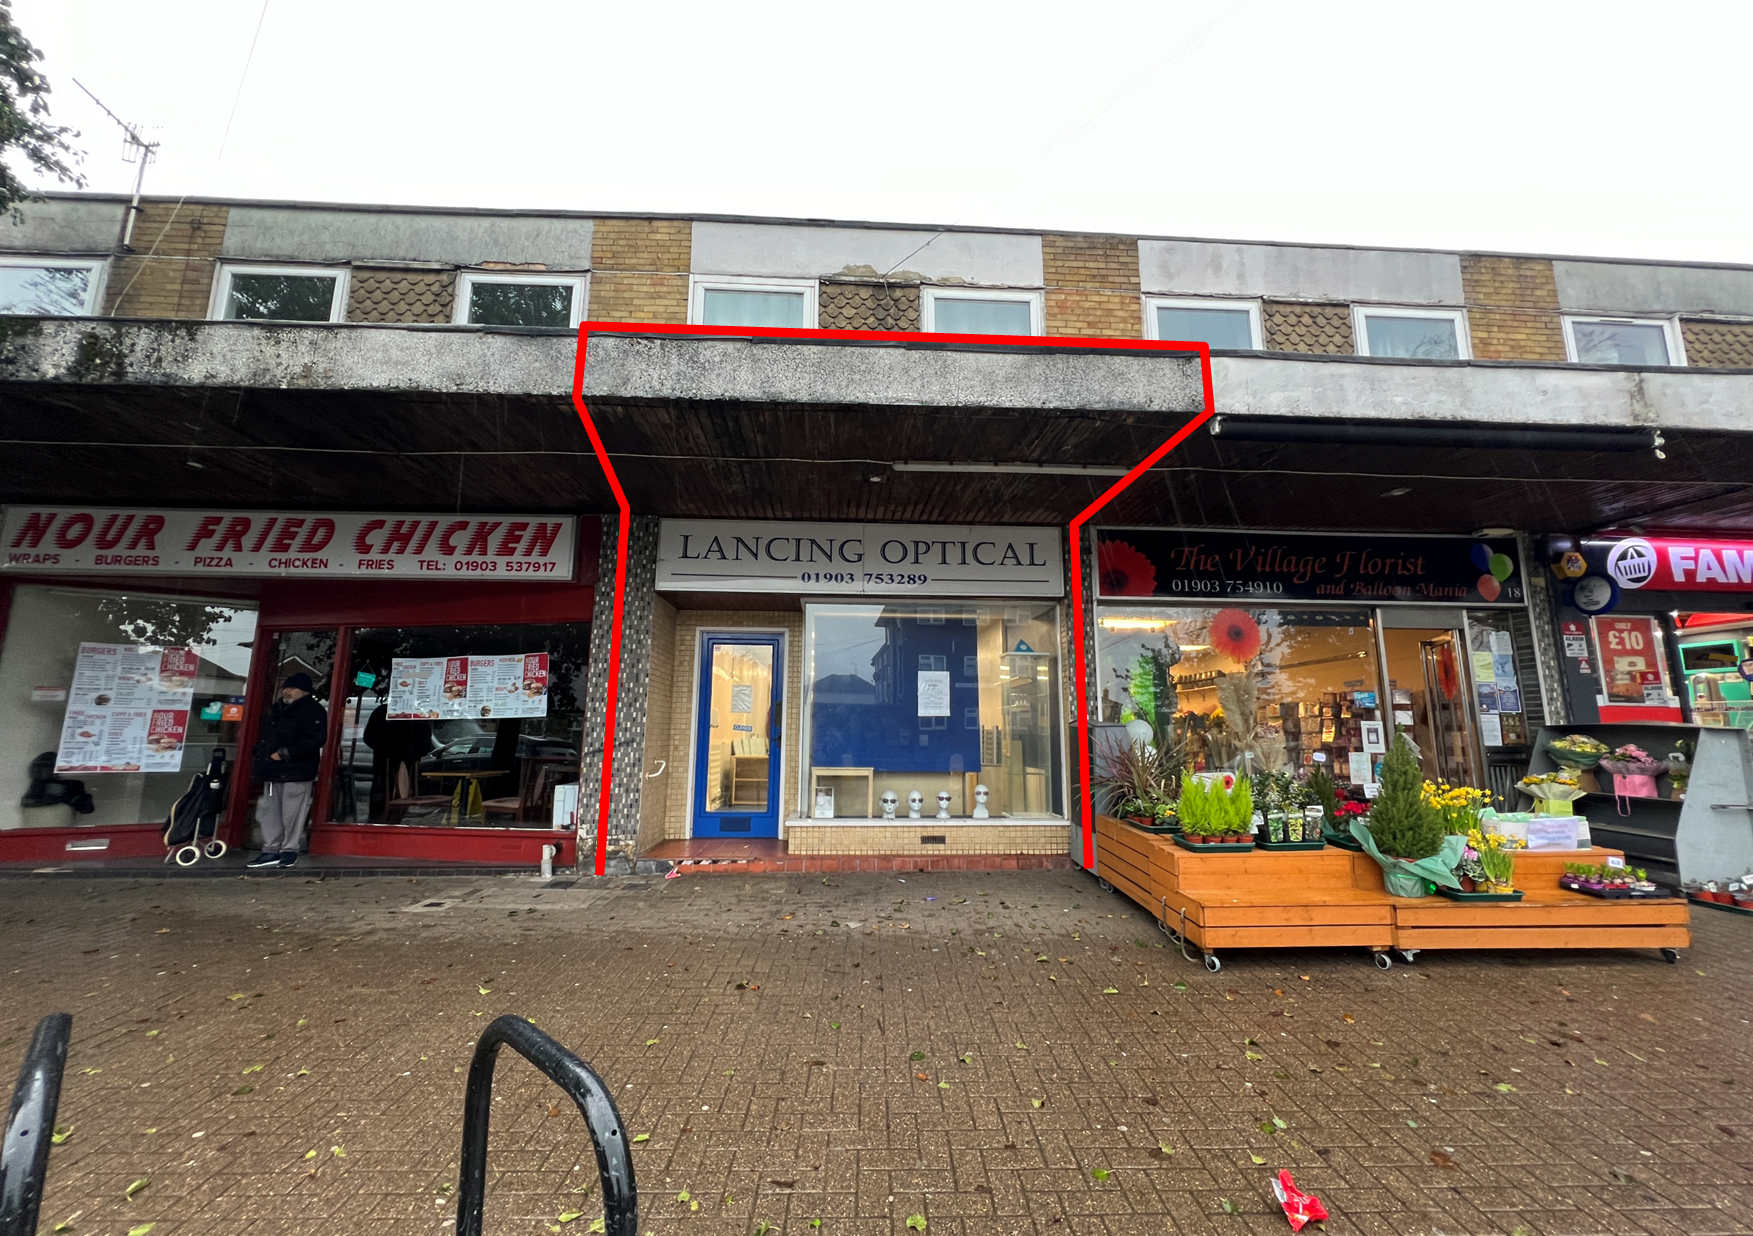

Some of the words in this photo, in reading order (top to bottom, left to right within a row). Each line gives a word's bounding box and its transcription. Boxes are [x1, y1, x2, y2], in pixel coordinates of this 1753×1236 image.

[9, 513, 165, 550] NOUR
[185, 516, 335, 553] FRIED
[353, 519, 563, 557] CHICKEN
[678, 534, 865, 564] LANCING
[880, 539, 1047, 567] OPTICAL
[8, 553, 61, 565] WRAPS
[94, 555, 160, 566] BURGERS
[193, 557, 233, 568] PIZZA
[268, 558, 329, 569] CHICKEN
[357, 559, 394, 570] FRIES
[418, 560, 446, 571] TEL:
[454, 560, 498, 572] 01903
[505, 561, 556, 573] 537917
[1170, 544, 1220, 571] The
[1229, 545, 1327, 584] Village
[1335, 549, 1426, 578] Florist
[801, 571, 855, 584] 01903
[863, 572, 928, 586] 753289
[1172, 579, 1220, 592] 01903
[1226, 580, 1283, 594] 754910
[1316, 580, 1347, 595] and
[1350, 581, 1411, 596] Balloon
[1416, 582, 1468, 597] Mania
[1507, 587, 1521, 598] 18
[1608, 630, 1644, 650] £10
[80, 646, 118, 655] BURGERS
[470, 659, 495, 667] BURGERS
[526, 656, 539, 664] NOUR
[525, 670, 546, 678] CHICKEN
[152, 719, 174, 727] FRIED
[154, 712, 174, 720] NOUR
